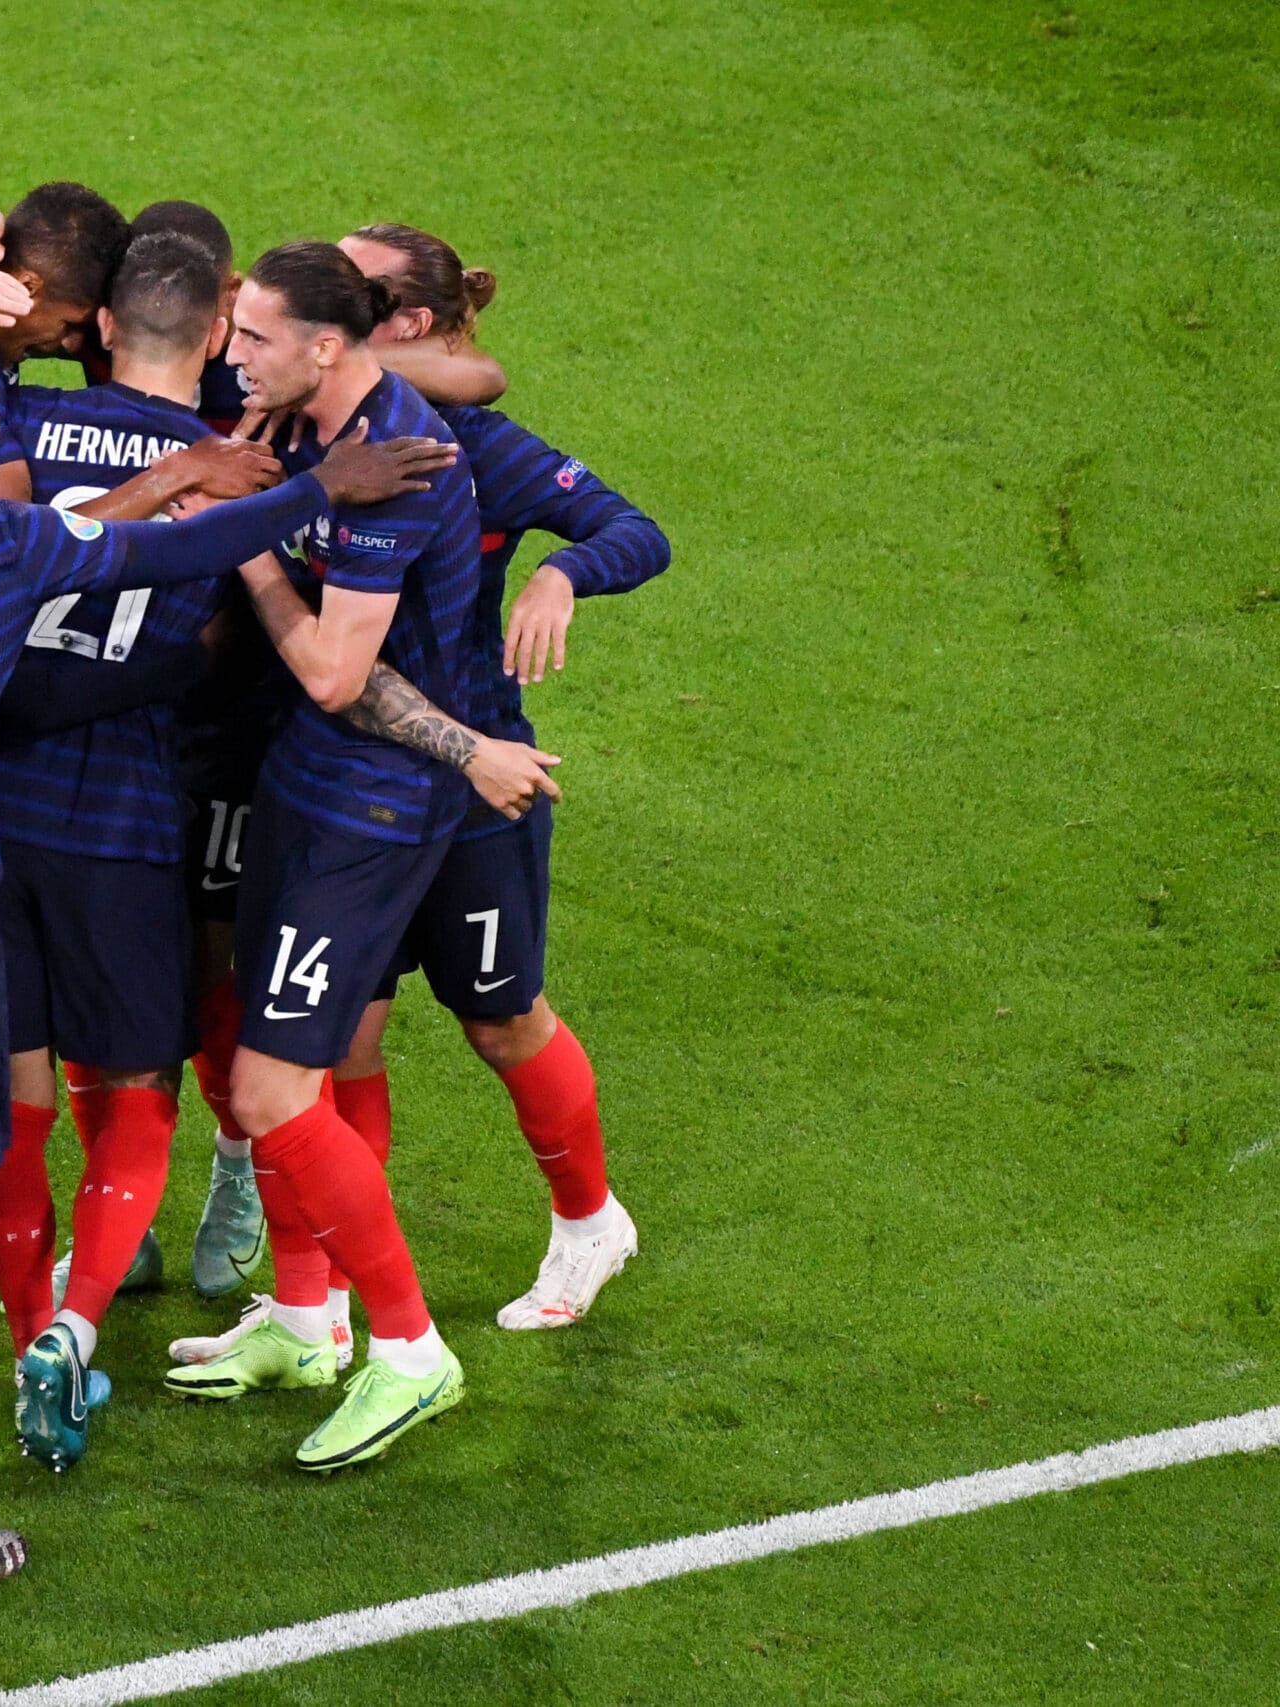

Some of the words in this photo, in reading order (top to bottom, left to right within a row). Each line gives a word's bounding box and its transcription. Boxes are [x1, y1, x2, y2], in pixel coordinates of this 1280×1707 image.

[350, 533, 397, 549] RESPECT
[268, 925, 332, 1006] 14
[465, 908, 499, 972] 7
